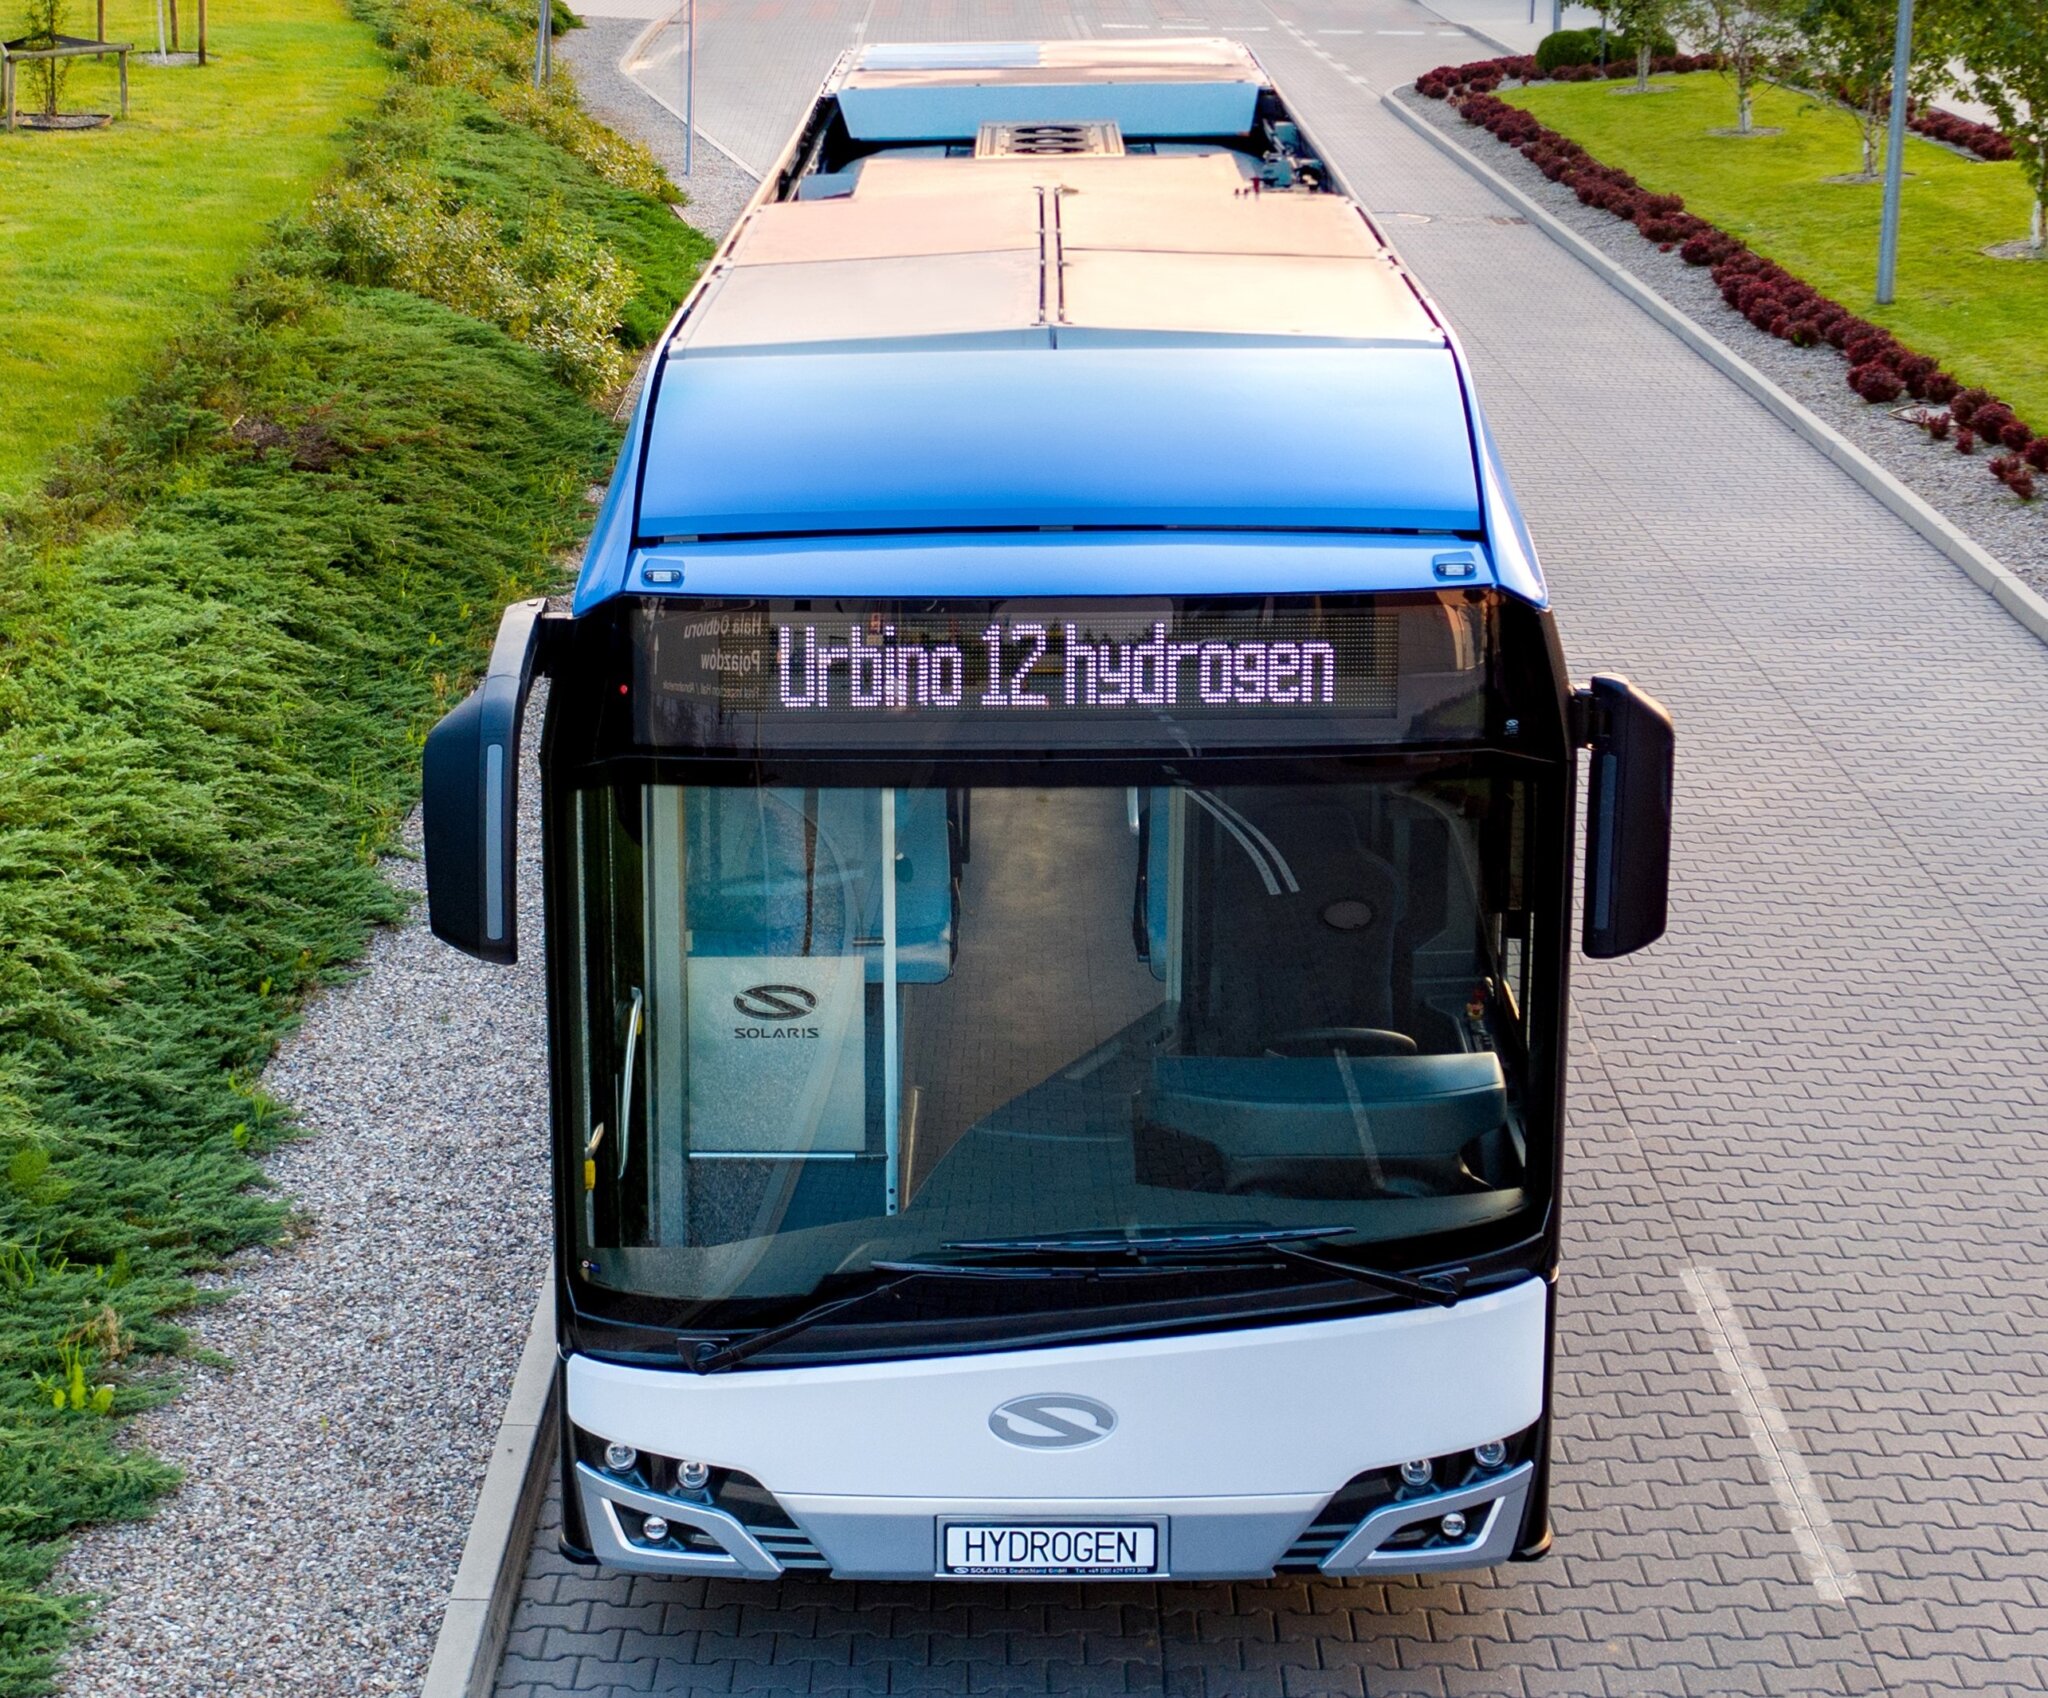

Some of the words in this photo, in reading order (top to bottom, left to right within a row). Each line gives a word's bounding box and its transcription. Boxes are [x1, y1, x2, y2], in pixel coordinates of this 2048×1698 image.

[778, 624, 963, 708] Urbino
[981, 623, 1047, 706] 12
[1065, 622, 1335, 705] hydrogen
[734, 1027, 820, 1039] SOLARIS
[965, 1530, 1138, 1563] HYDROGEN
